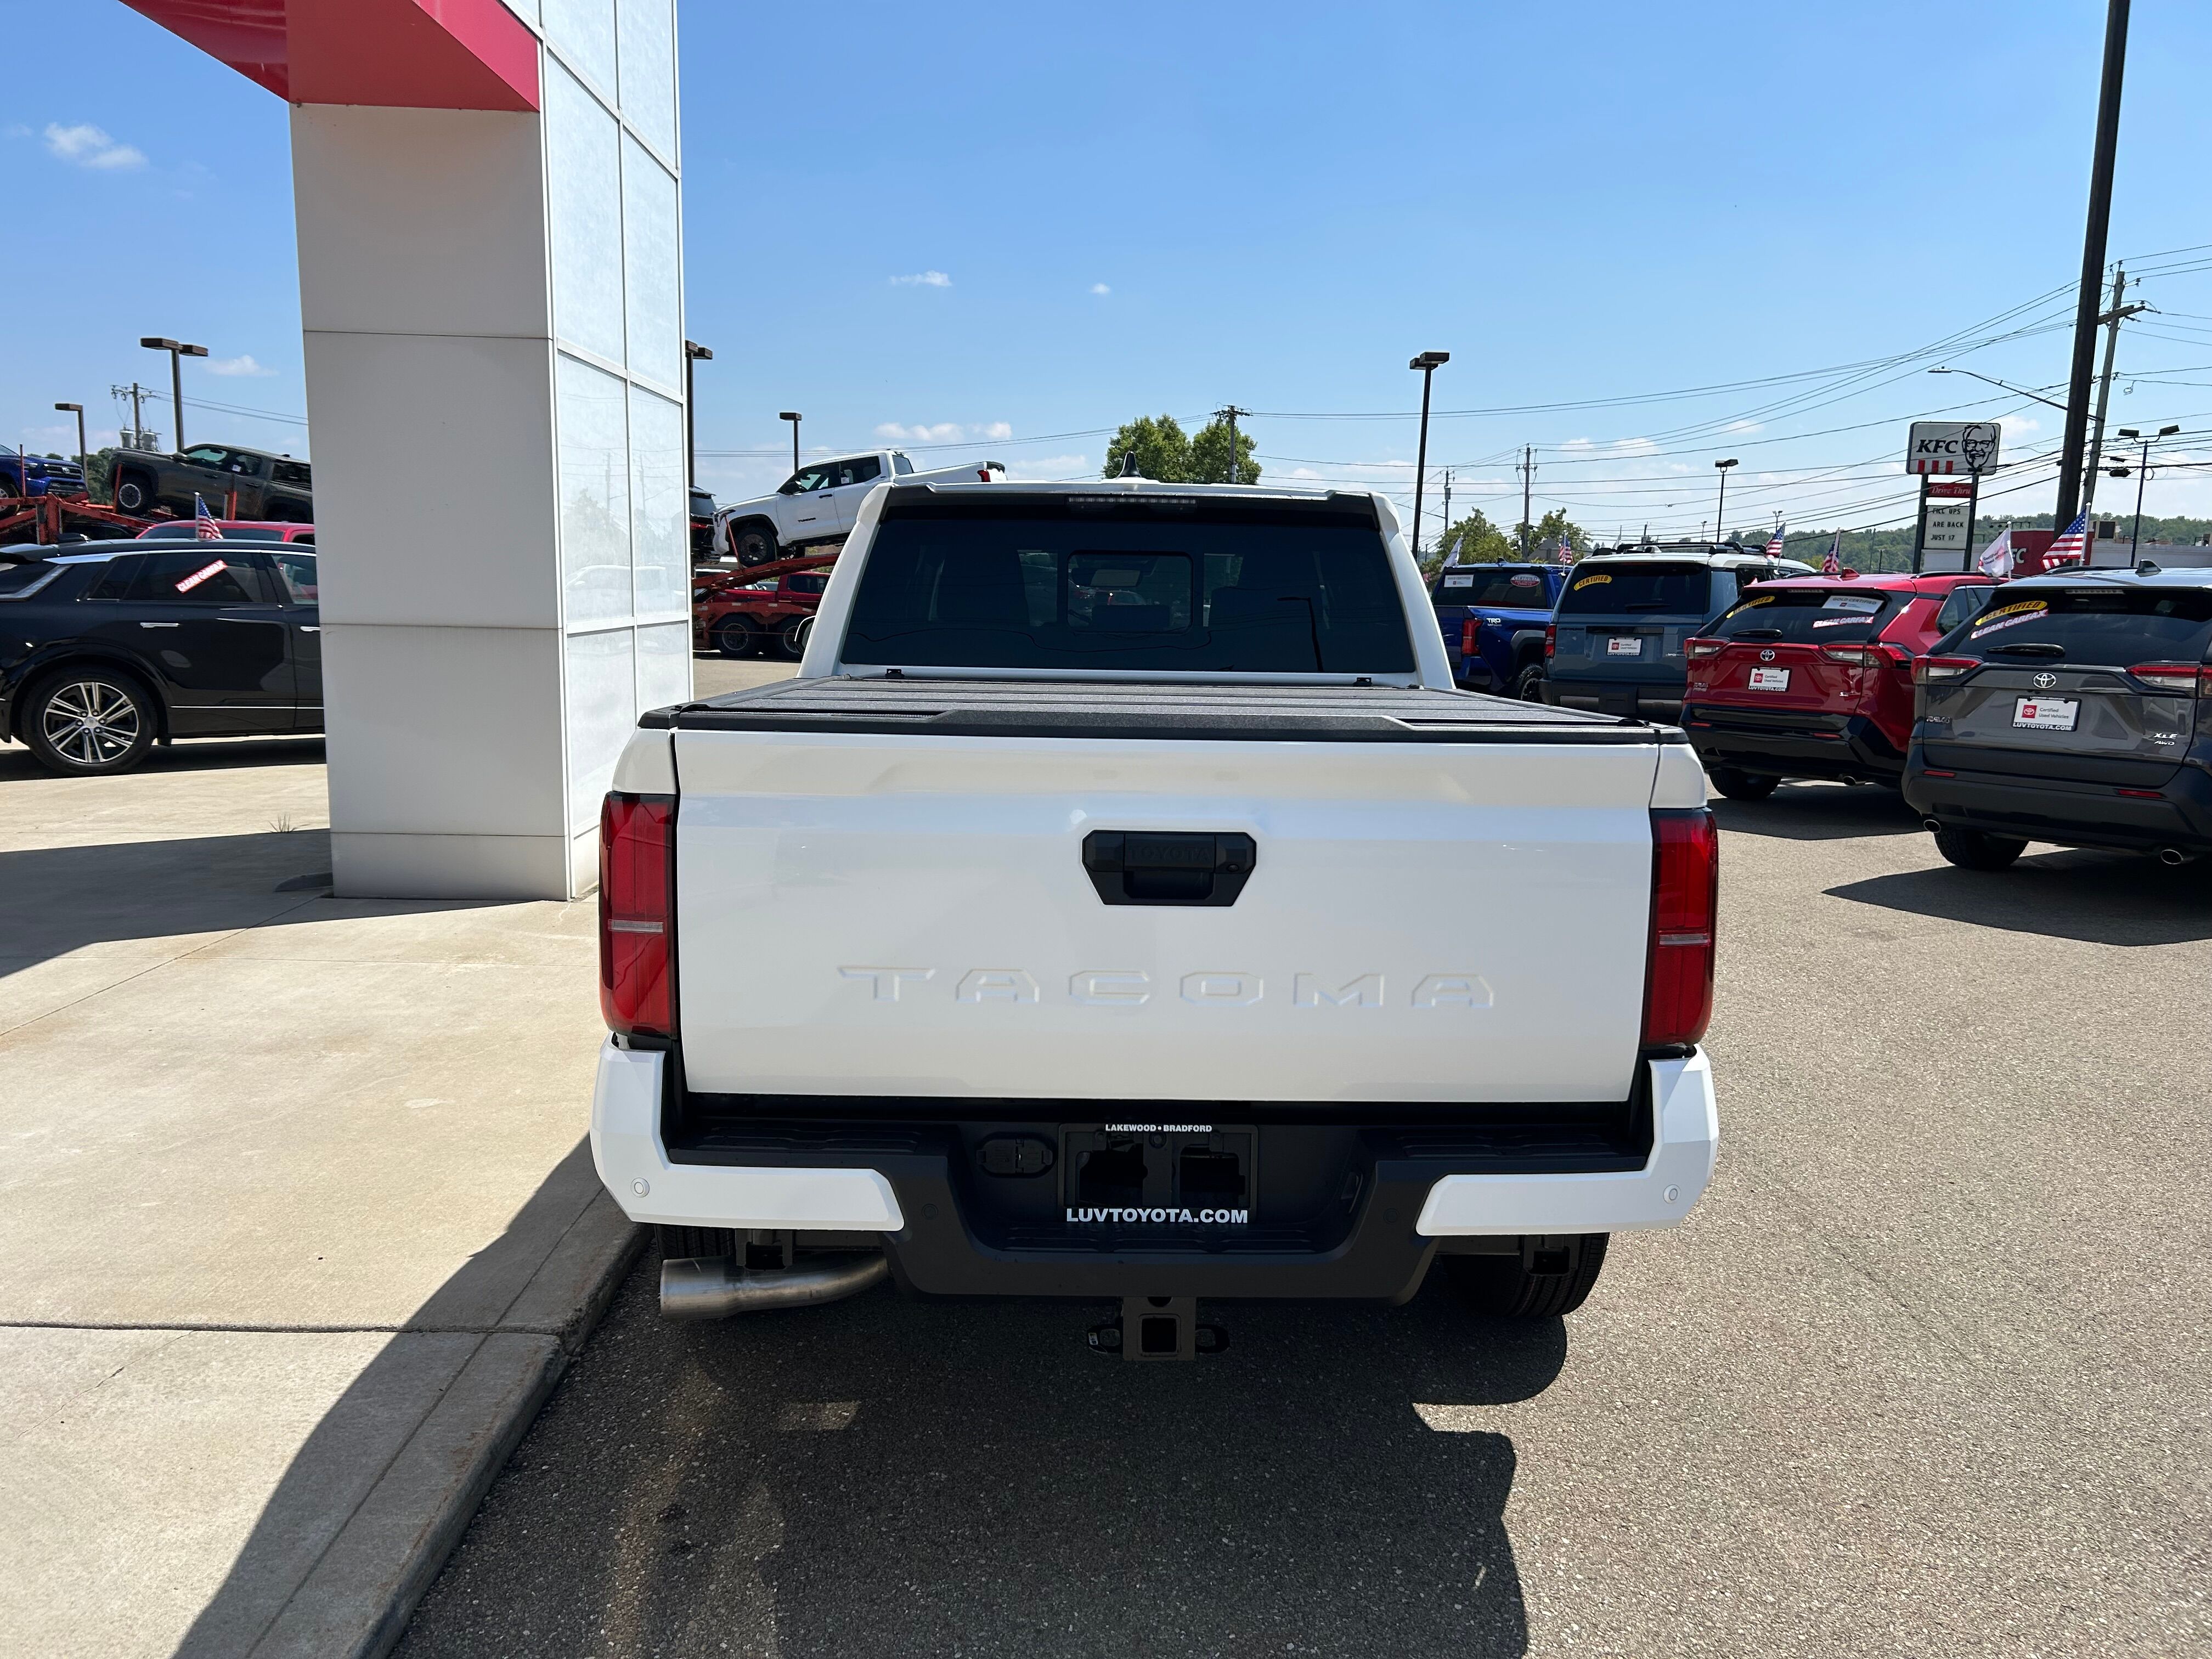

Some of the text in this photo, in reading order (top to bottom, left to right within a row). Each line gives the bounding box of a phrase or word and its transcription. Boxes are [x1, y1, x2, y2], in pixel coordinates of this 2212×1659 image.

[1916, 439, 1958, 453] KFC
[1579, 575, 1608, 587] CERTIFIED
[1985, 601, 2041, 619] CERTIFIED
[2005, 610, 2046, 627] CARFAX
[2013, 722, 2072, 731] LUVTOYOTA.COM
[837, 965, 1494, 1008] TACOMA
[1066, 1208, 1248, 1223] LUVTOYOTA.COM
